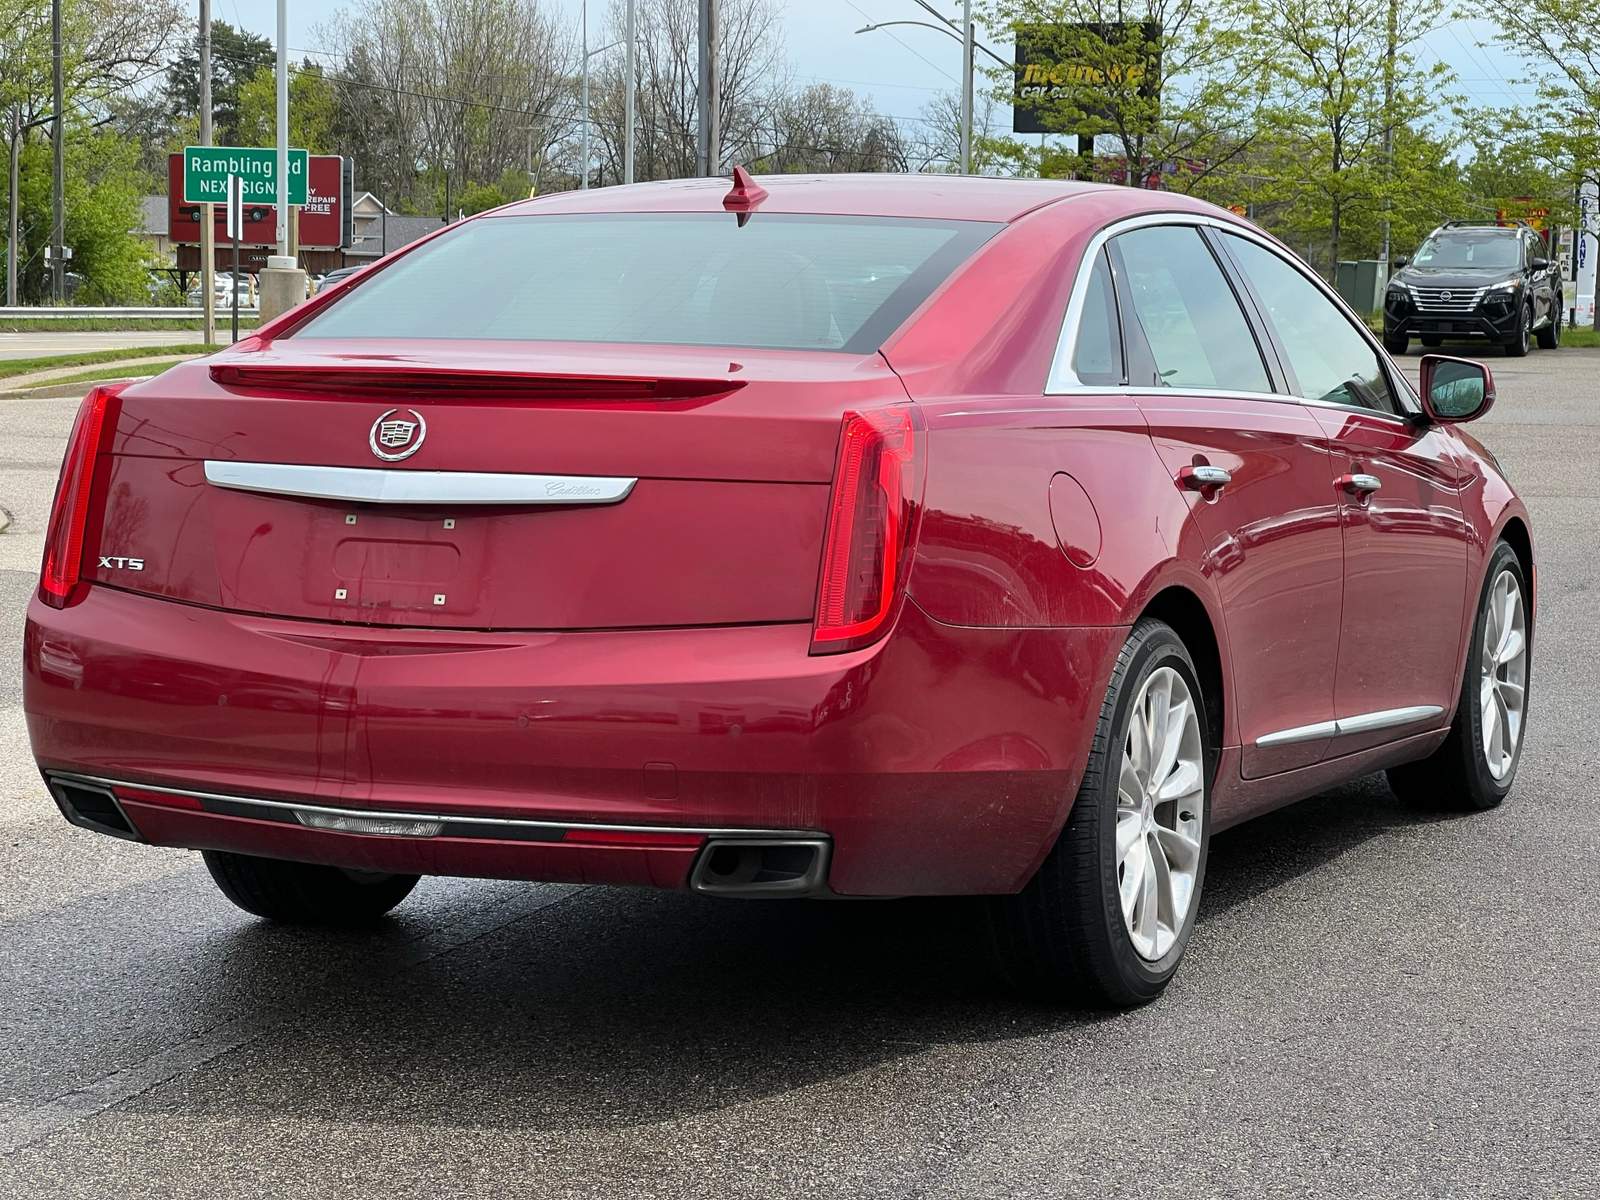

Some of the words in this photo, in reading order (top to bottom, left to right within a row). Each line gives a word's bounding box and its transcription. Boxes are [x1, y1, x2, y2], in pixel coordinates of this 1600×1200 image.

[191, 157, 273, 178] Rambling
[200, 180, 231, 194] NEX
[242, 181, 292, 195] SIGN
[304, 203, 331, 212] FREE
[544, 481, 601, 497] Cadillac
[97, 556, 144, 570] XTS
